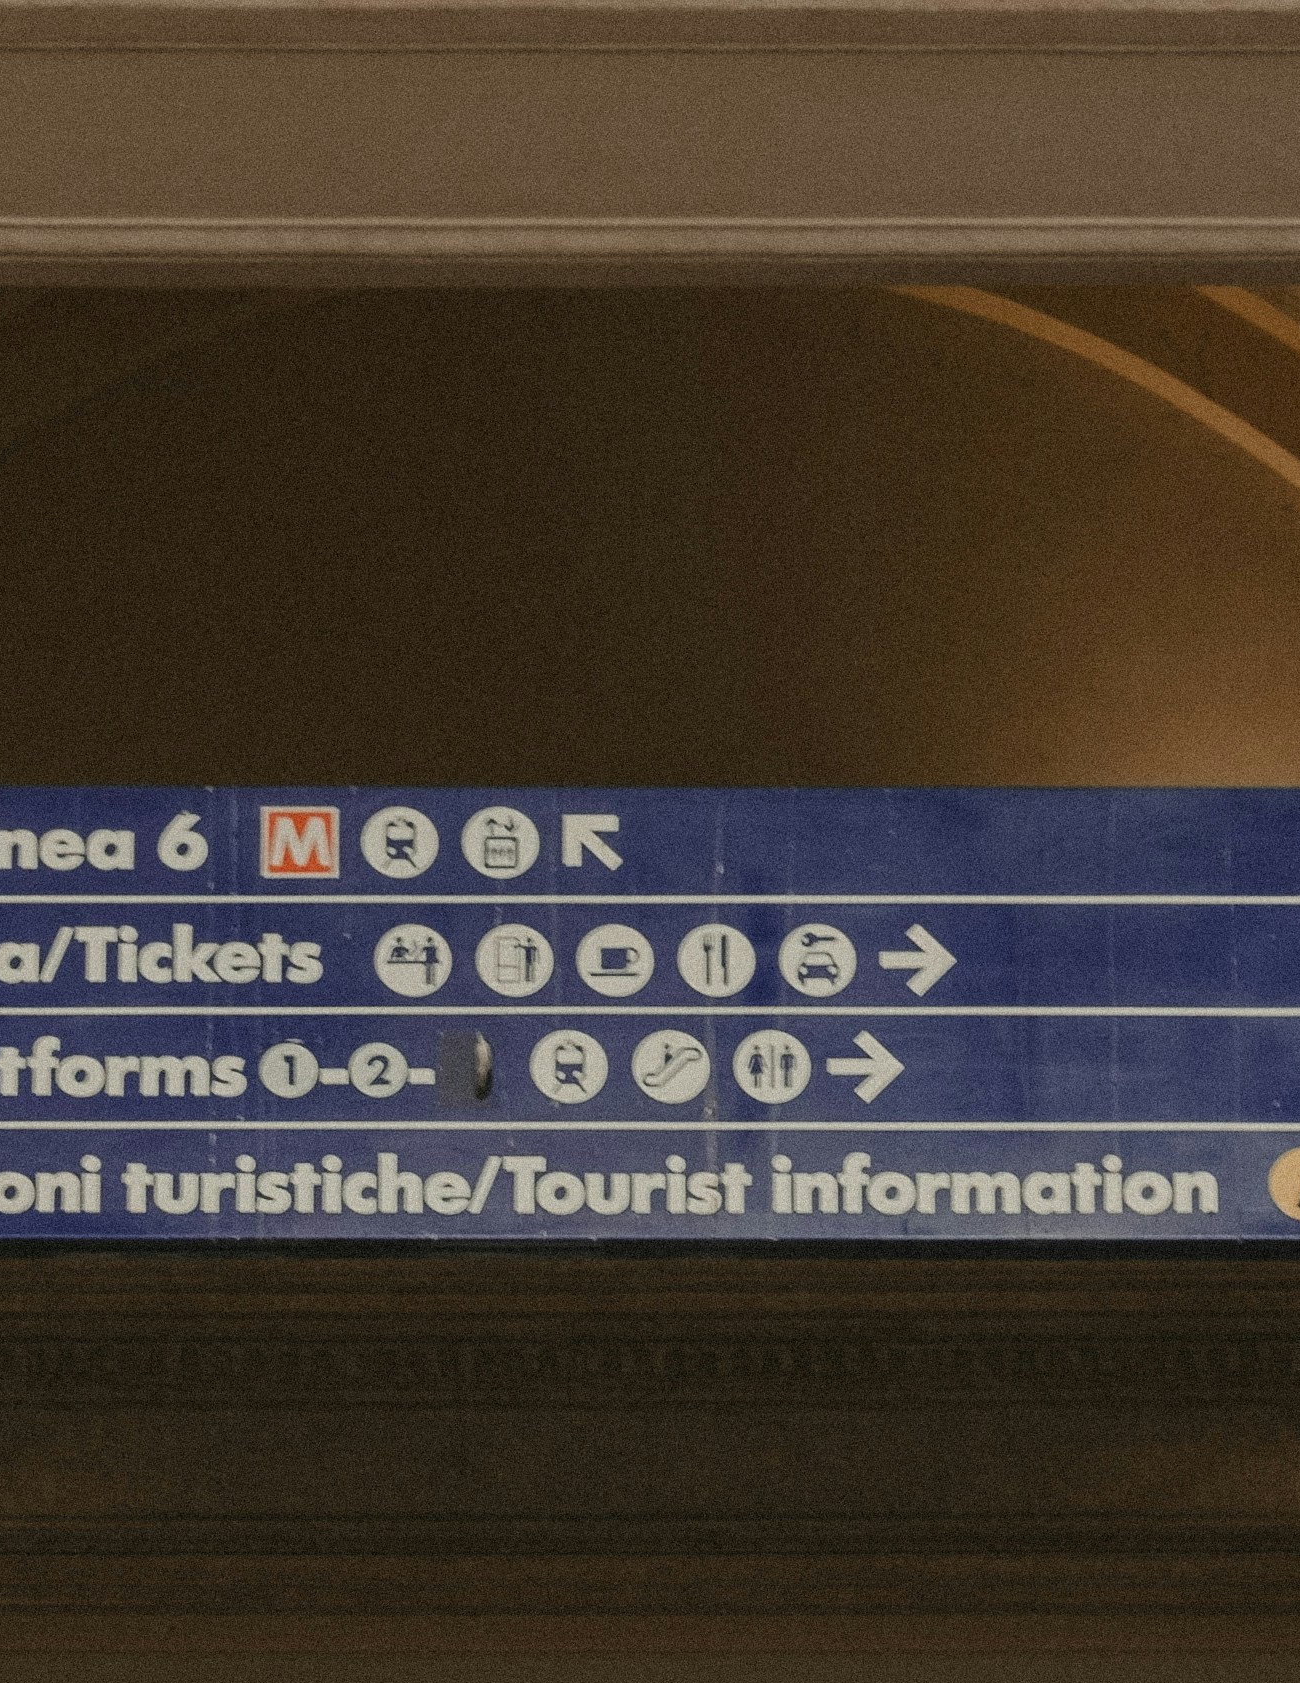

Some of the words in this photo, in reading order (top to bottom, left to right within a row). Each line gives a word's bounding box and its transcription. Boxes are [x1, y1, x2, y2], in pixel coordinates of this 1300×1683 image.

[157, 813, 209, 871] 6
[121, 1152, 753, 1216] turistiche/Tourist
[771, 1151, 1219, 1216] information
